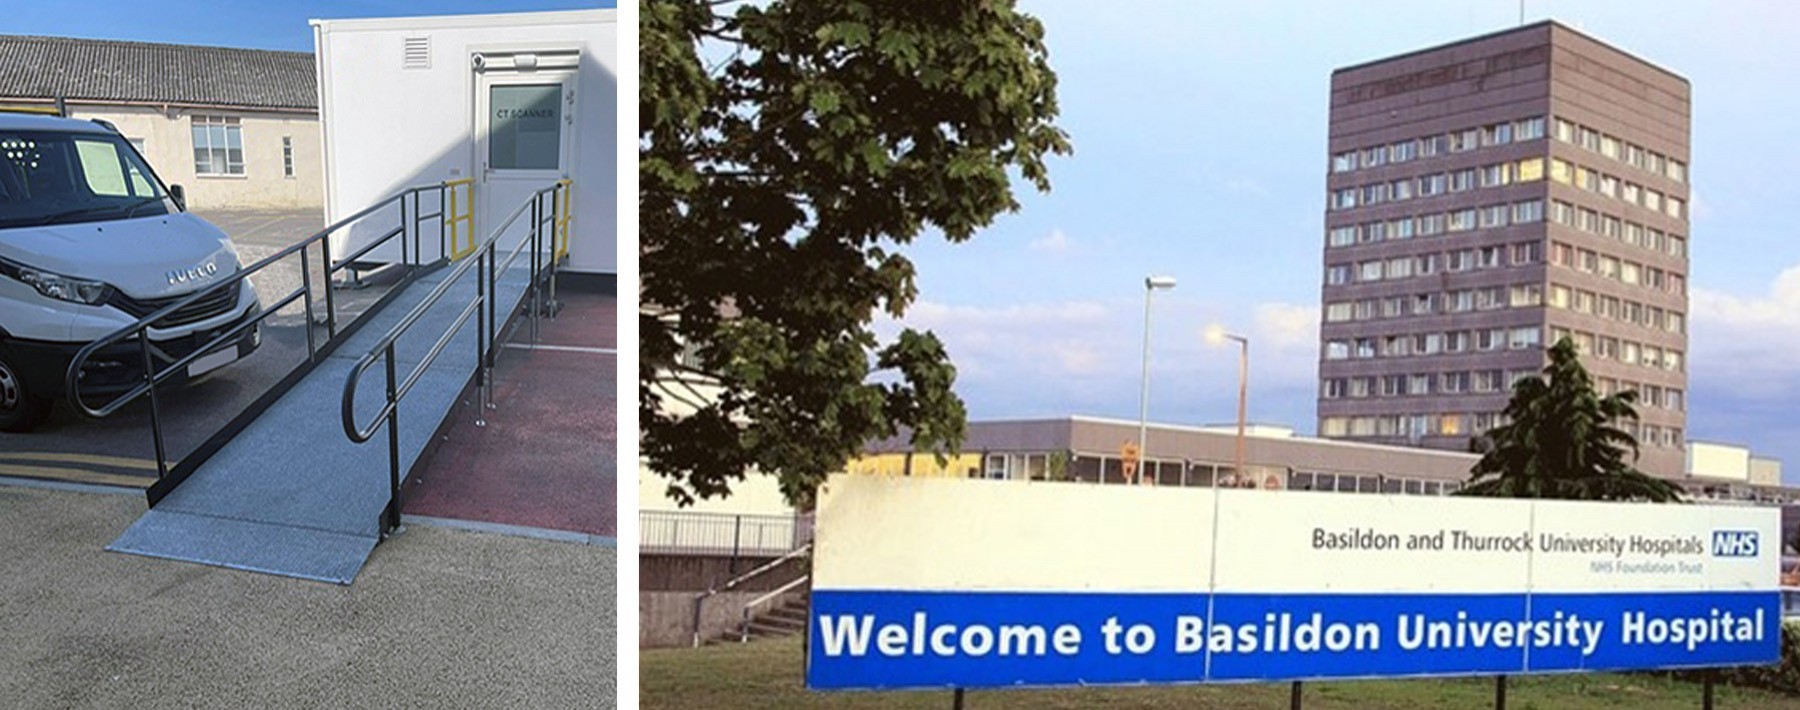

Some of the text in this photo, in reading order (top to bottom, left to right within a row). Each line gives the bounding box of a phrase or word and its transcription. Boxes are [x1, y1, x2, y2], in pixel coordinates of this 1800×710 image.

[496, 108, 554, 119] CT SCANNER
[1311, 527, 1703, 557] Basildon and Thurrock University Hospitals
[1713, 532, 1758, 556] NHS
[1590, 561, 1703, 574] NHS Foundation Trust
[819, 607, 1764, 656] Welcome to Basildon University Hospital
